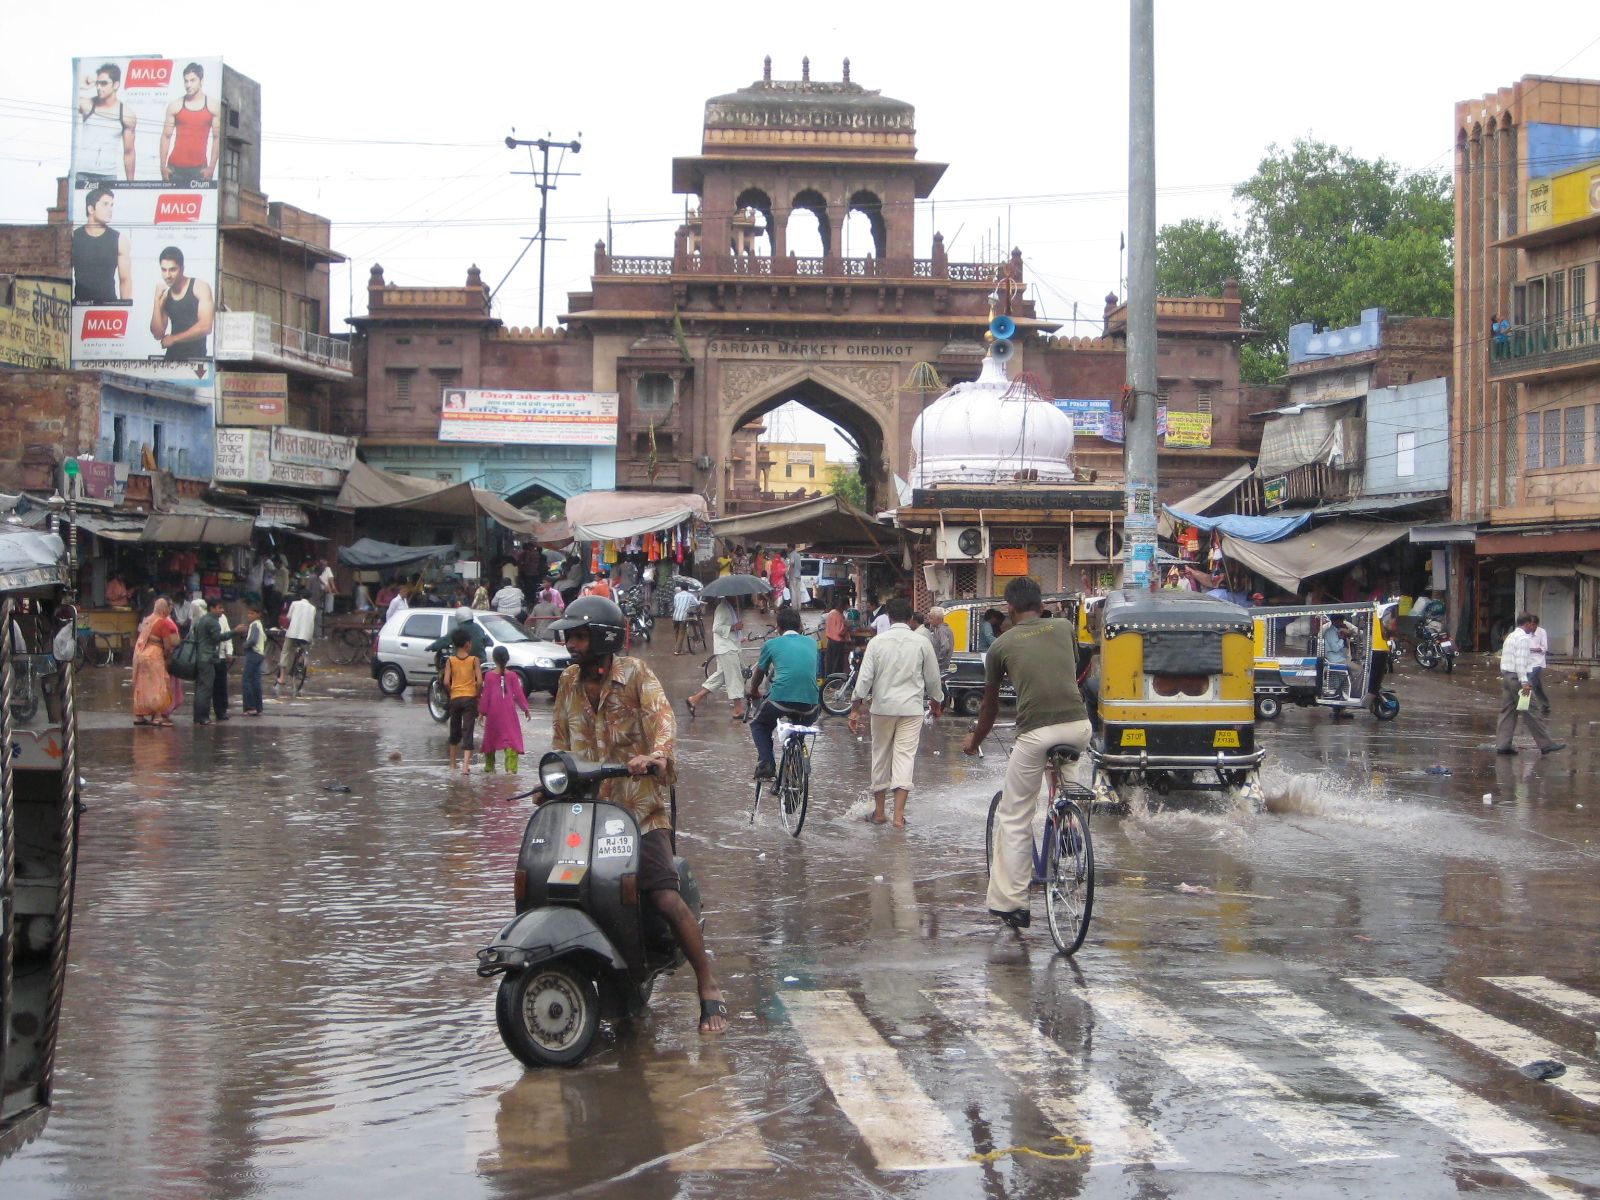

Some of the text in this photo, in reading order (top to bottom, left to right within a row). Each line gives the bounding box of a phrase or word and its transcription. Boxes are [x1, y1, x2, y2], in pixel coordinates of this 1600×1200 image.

[131, 67, 168, 80] MALO
[83, 181, 99, 190] Zest
[160, 202, 197, 215] MALO
[87, 318, 123, 331] MALO
[711, 343, 770, 354] SARDAR
[778, 344, 838, 355] MARKET
[218, 430, 244, 444] होटल
[274, 433, 298, 455] भारत
[272, 464, 290, 480] भारत
[1126, 733, 1144, 741] STOP
[598, 845, 632, 856] AM-8530
